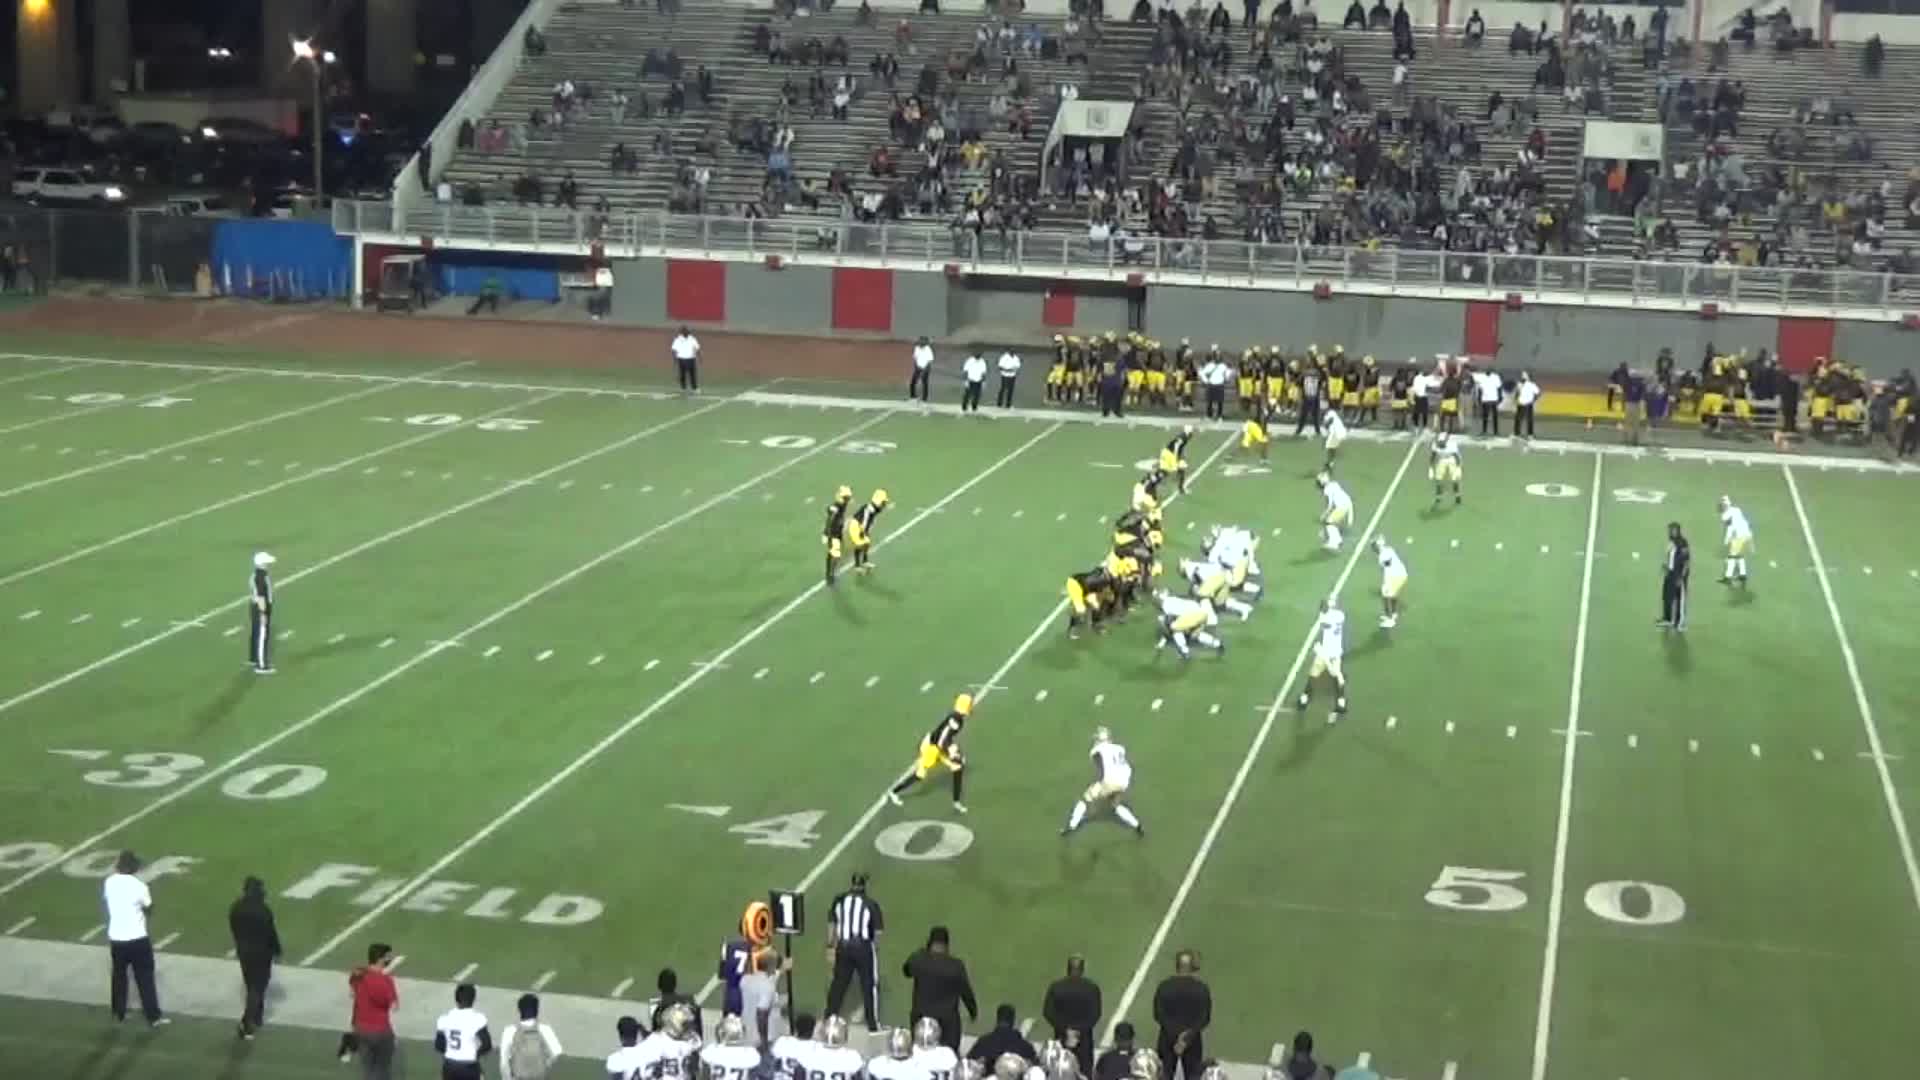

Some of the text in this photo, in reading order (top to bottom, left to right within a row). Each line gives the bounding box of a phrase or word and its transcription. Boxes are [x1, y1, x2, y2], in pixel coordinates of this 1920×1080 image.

[83, 752, 328, 799] 30
[728, 809, 974, 861] 40
[281, 863, 604, 925] FIELD
[779, 893, 794, 927] 1
[1424, 864, 1686, 925] 50
[449, 1029, 462, 1050] 5
